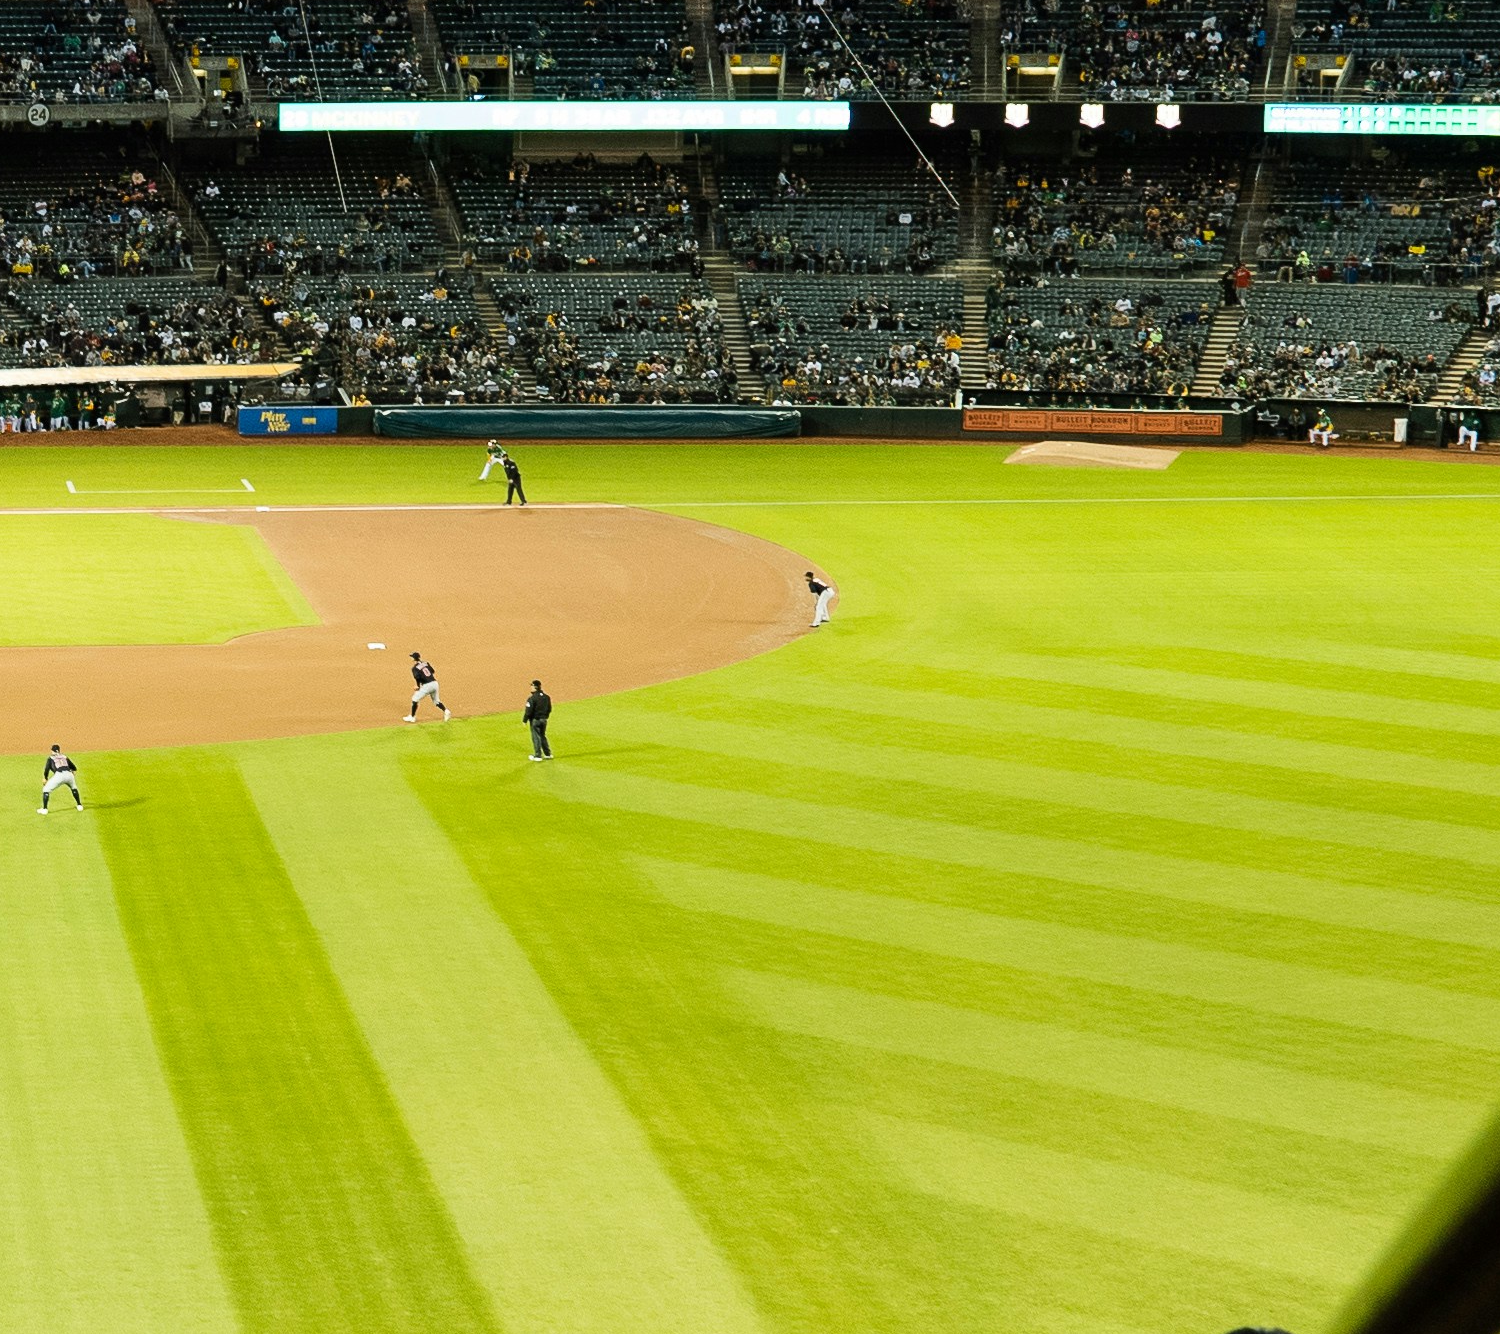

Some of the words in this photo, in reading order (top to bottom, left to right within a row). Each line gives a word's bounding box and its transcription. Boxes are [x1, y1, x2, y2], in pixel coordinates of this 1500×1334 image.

[30, 108, 47, 122] 24
[311, 110, 420, 128] MCKINNEY
[1056, 415, 1089, 424] BULLEIT
